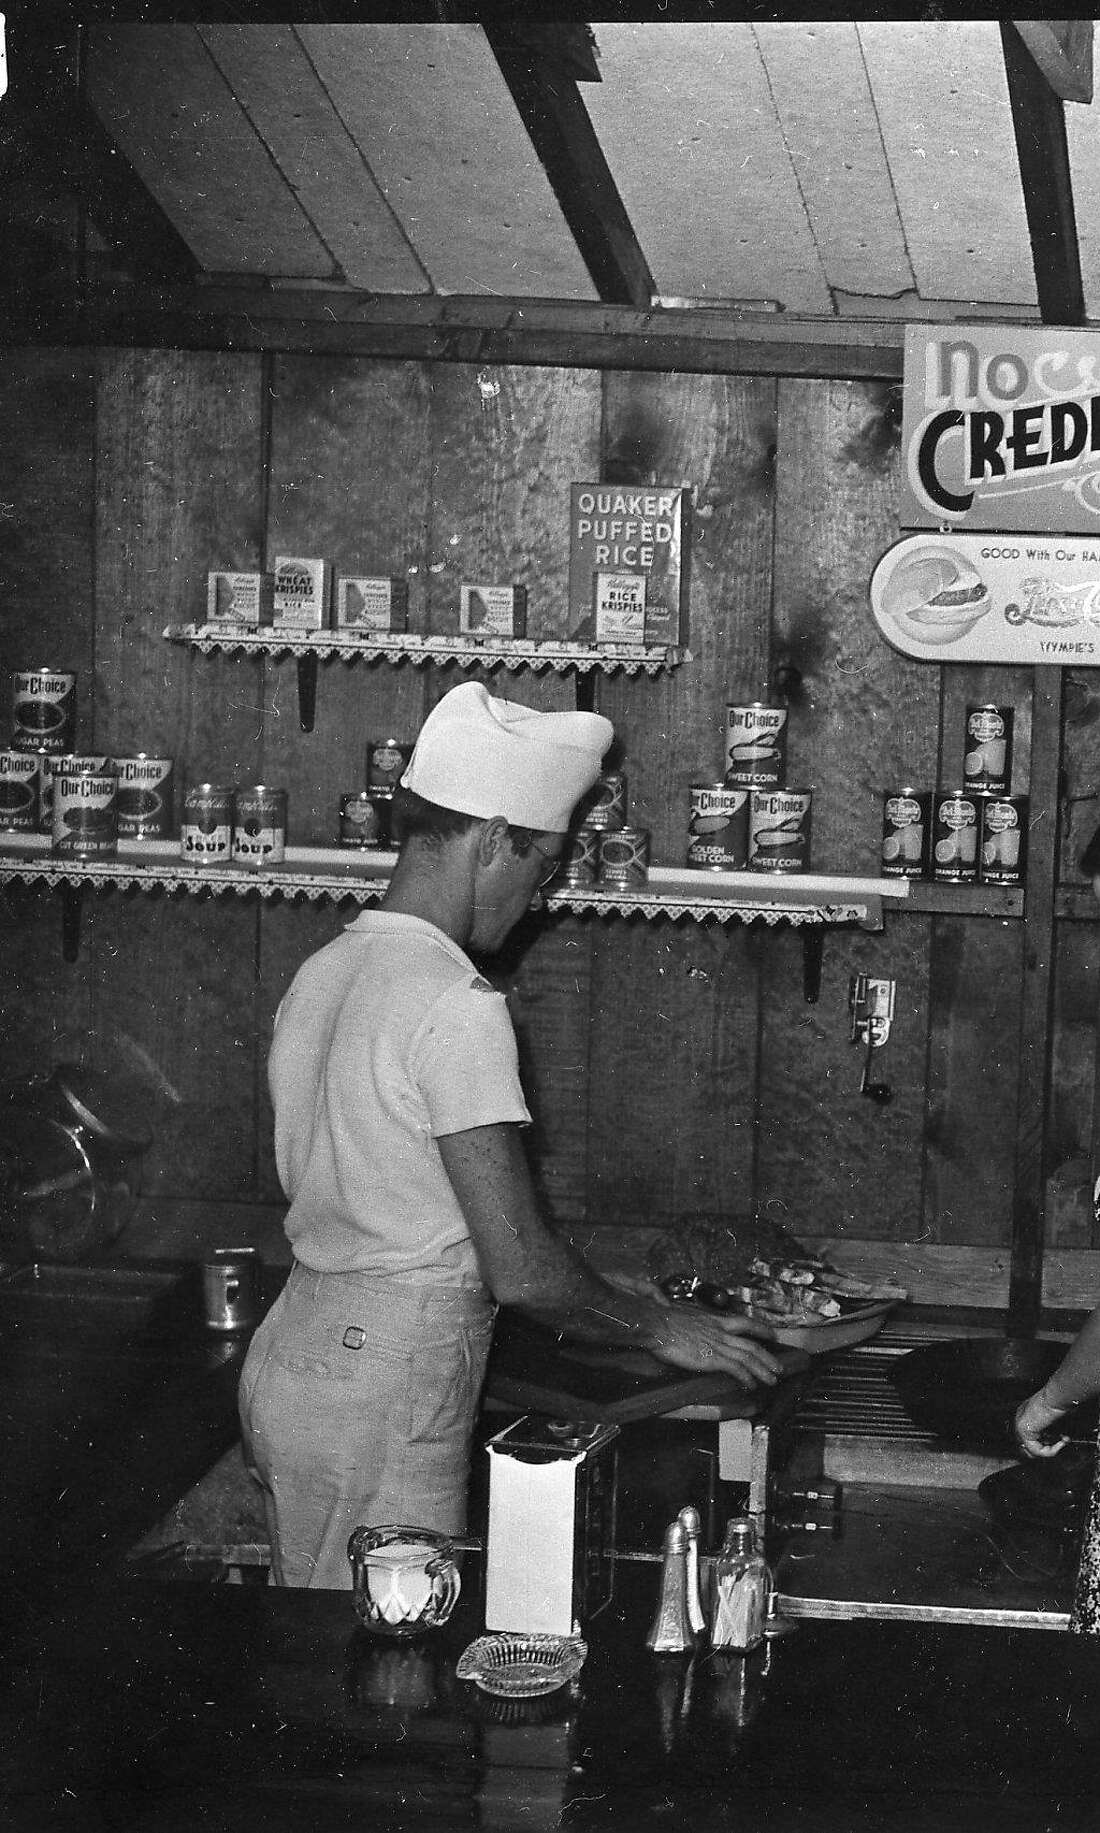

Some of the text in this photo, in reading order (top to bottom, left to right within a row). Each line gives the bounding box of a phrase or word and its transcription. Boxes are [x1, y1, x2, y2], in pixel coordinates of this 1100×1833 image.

[578, 493, 674, 517] QUAKER
[577, 520, 673, 543] PUFFED
[595, 544, 654, 566] RICE
[981, 548, 1020, 559] GOOD
[1026, 549, 1050, 561] With
[1055, 550, 1076, 562] Our
[609, 592, 637, 602] RICE
[602, 601, 643, 612] KRISPIES
[745, 712, 779, 729] Choice
[753, 773, 778, 782] CORN
[61, 779, 79, 797] Our
[701, 792, 735, 810] Choice
[770, 797, 804, 815] Choice
[709, 854, 735, 863] CORN
